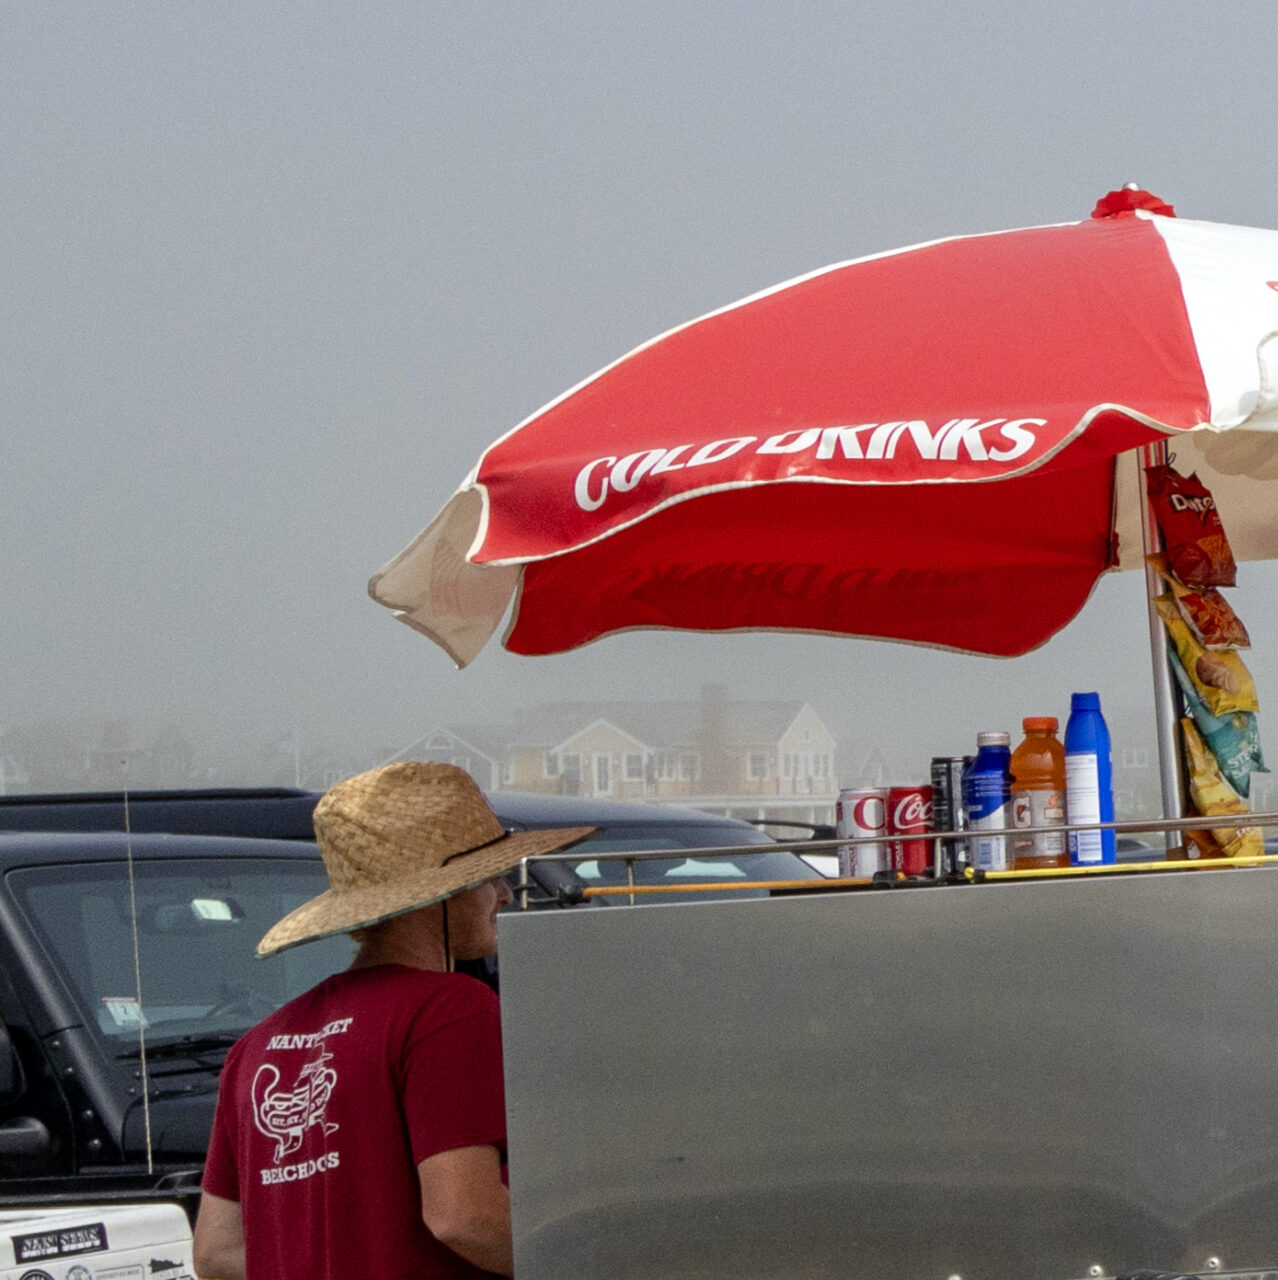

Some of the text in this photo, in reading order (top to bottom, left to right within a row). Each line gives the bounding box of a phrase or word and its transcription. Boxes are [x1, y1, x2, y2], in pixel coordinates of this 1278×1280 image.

[574, 418, 1048, 512] COLD DRINKS
[266, 1017, 354, 1050] NANTKET
